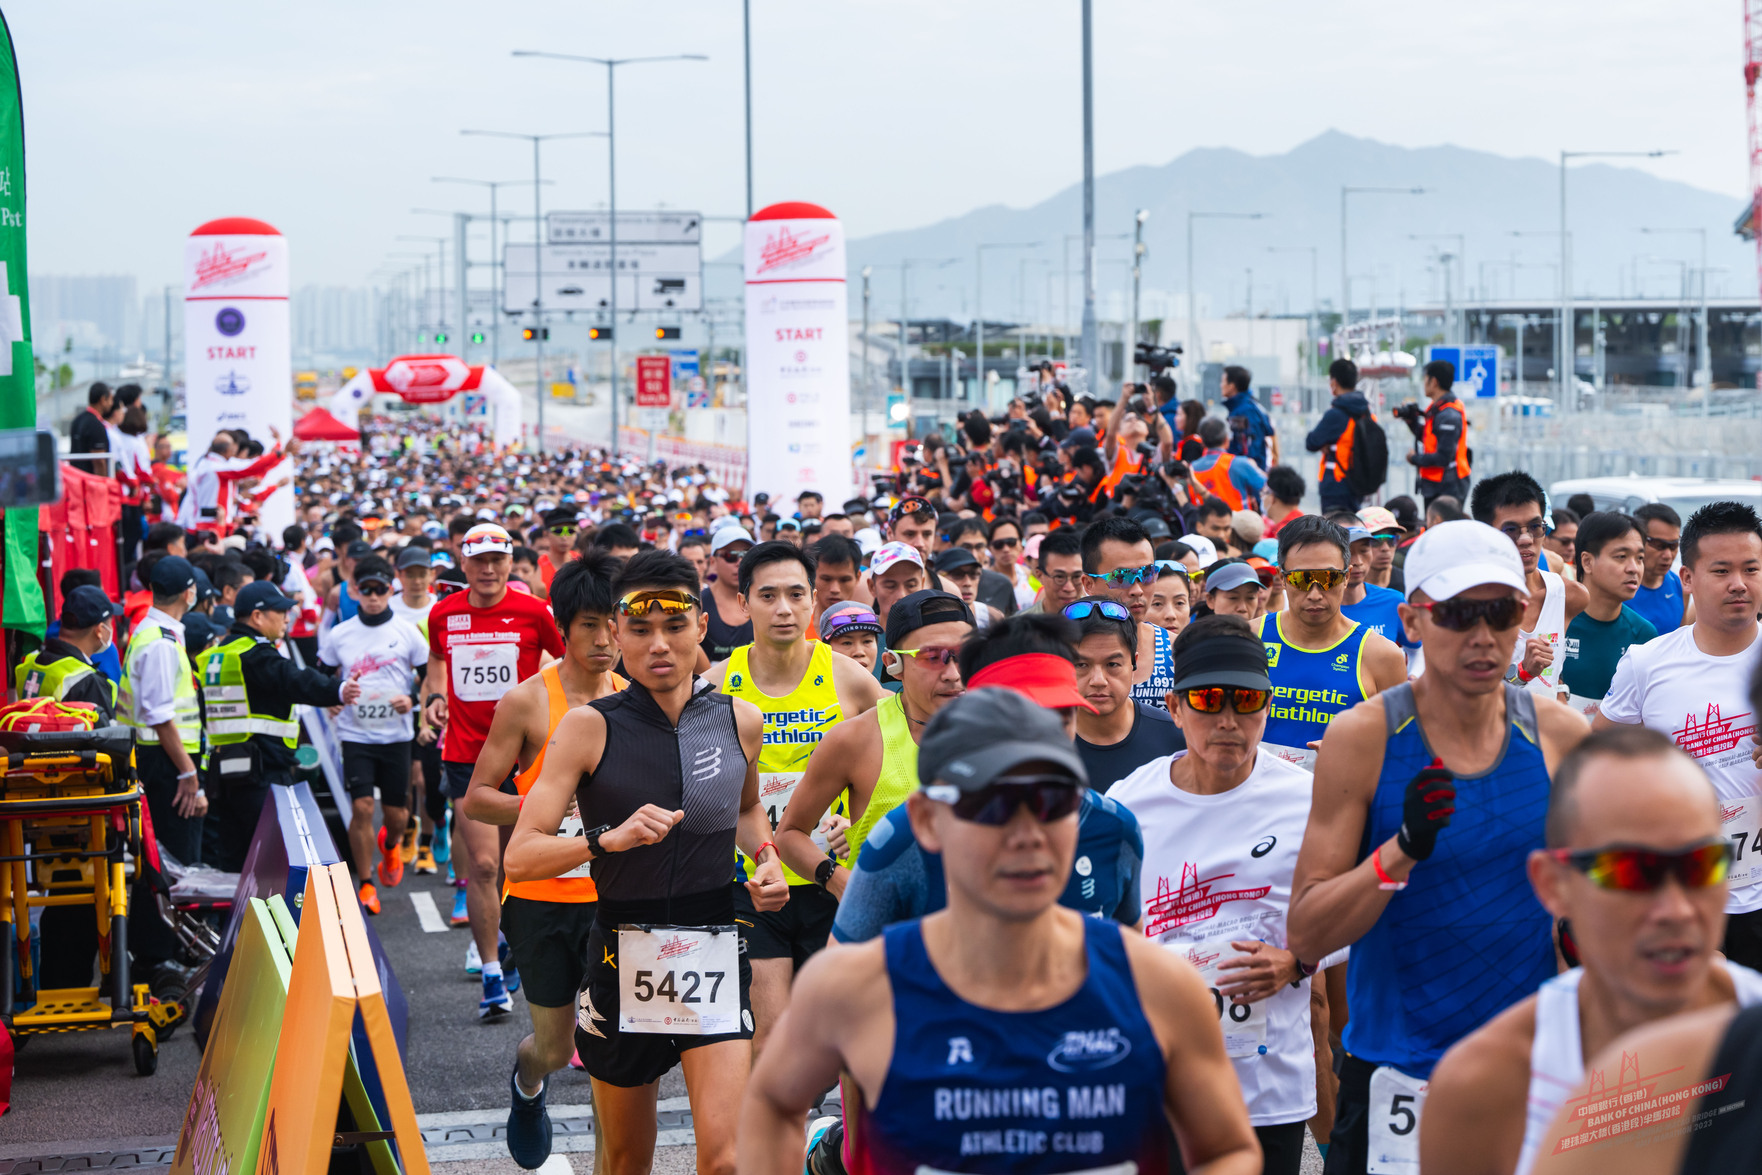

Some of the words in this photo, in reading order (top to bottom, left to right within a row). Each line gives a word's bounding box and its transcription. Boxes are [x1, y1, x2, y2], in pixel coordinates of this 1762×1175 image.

[1, 207, 23, 227] Pst
[776, 328, 823, 342] START
[207, 346, 257, 361] START
[461, 665, 511, 684] 7550
[1270, 686, 1348, 706] ergetic
[358, 705, 396, 719] 5227
[1270, 703, 1336, 724] iathlo
[762, 728, 823, 744] athlon
[1686, 739, 1703, 750] BANK
[1177, 907, 1187, 915] OF
[634, 970, 725, 1004] 5427
[935, 1087, 1060, 1120] RUNNING
[1067, 1083, 1126, 1119] MAN
[1388, 1094, 1416, 1136] 5
[961, 1129, 1048, 1156] ATHLETIC
[1052, 1130, 1104, 1154] CLUB
